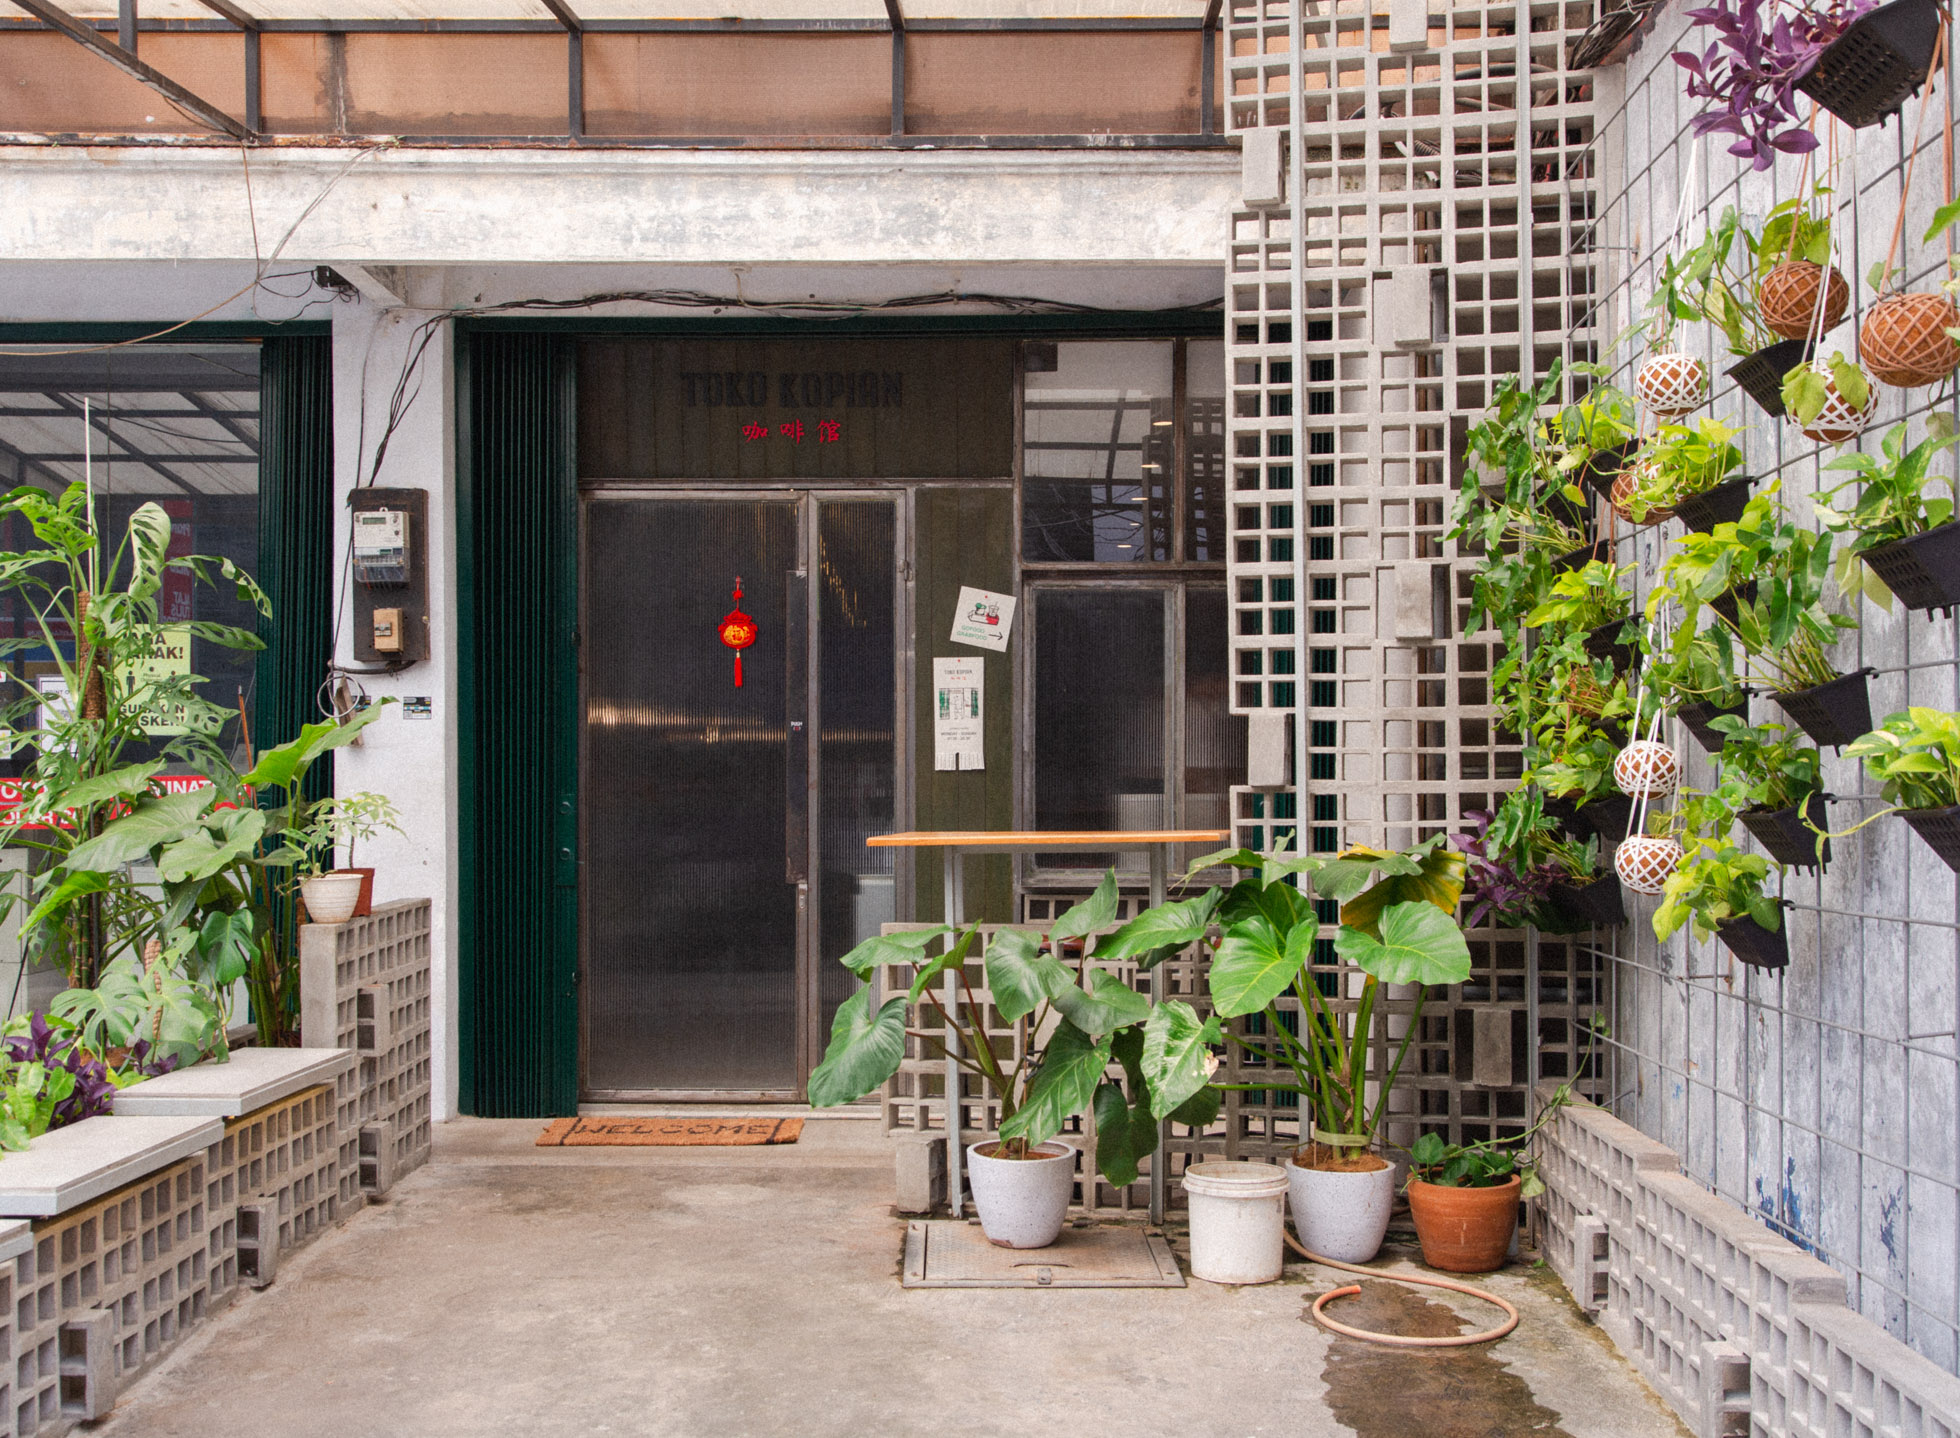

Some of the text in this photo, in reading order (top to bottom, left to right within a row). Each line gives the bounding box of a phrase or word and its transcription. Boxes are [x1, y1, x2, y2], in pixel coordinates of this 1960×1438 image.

[680, 371, 904, 409] TOKO KOPIAN
[742, 419, 842, 444] 咖啡馆
[574, 1124, 771, 1135] WELCOME
